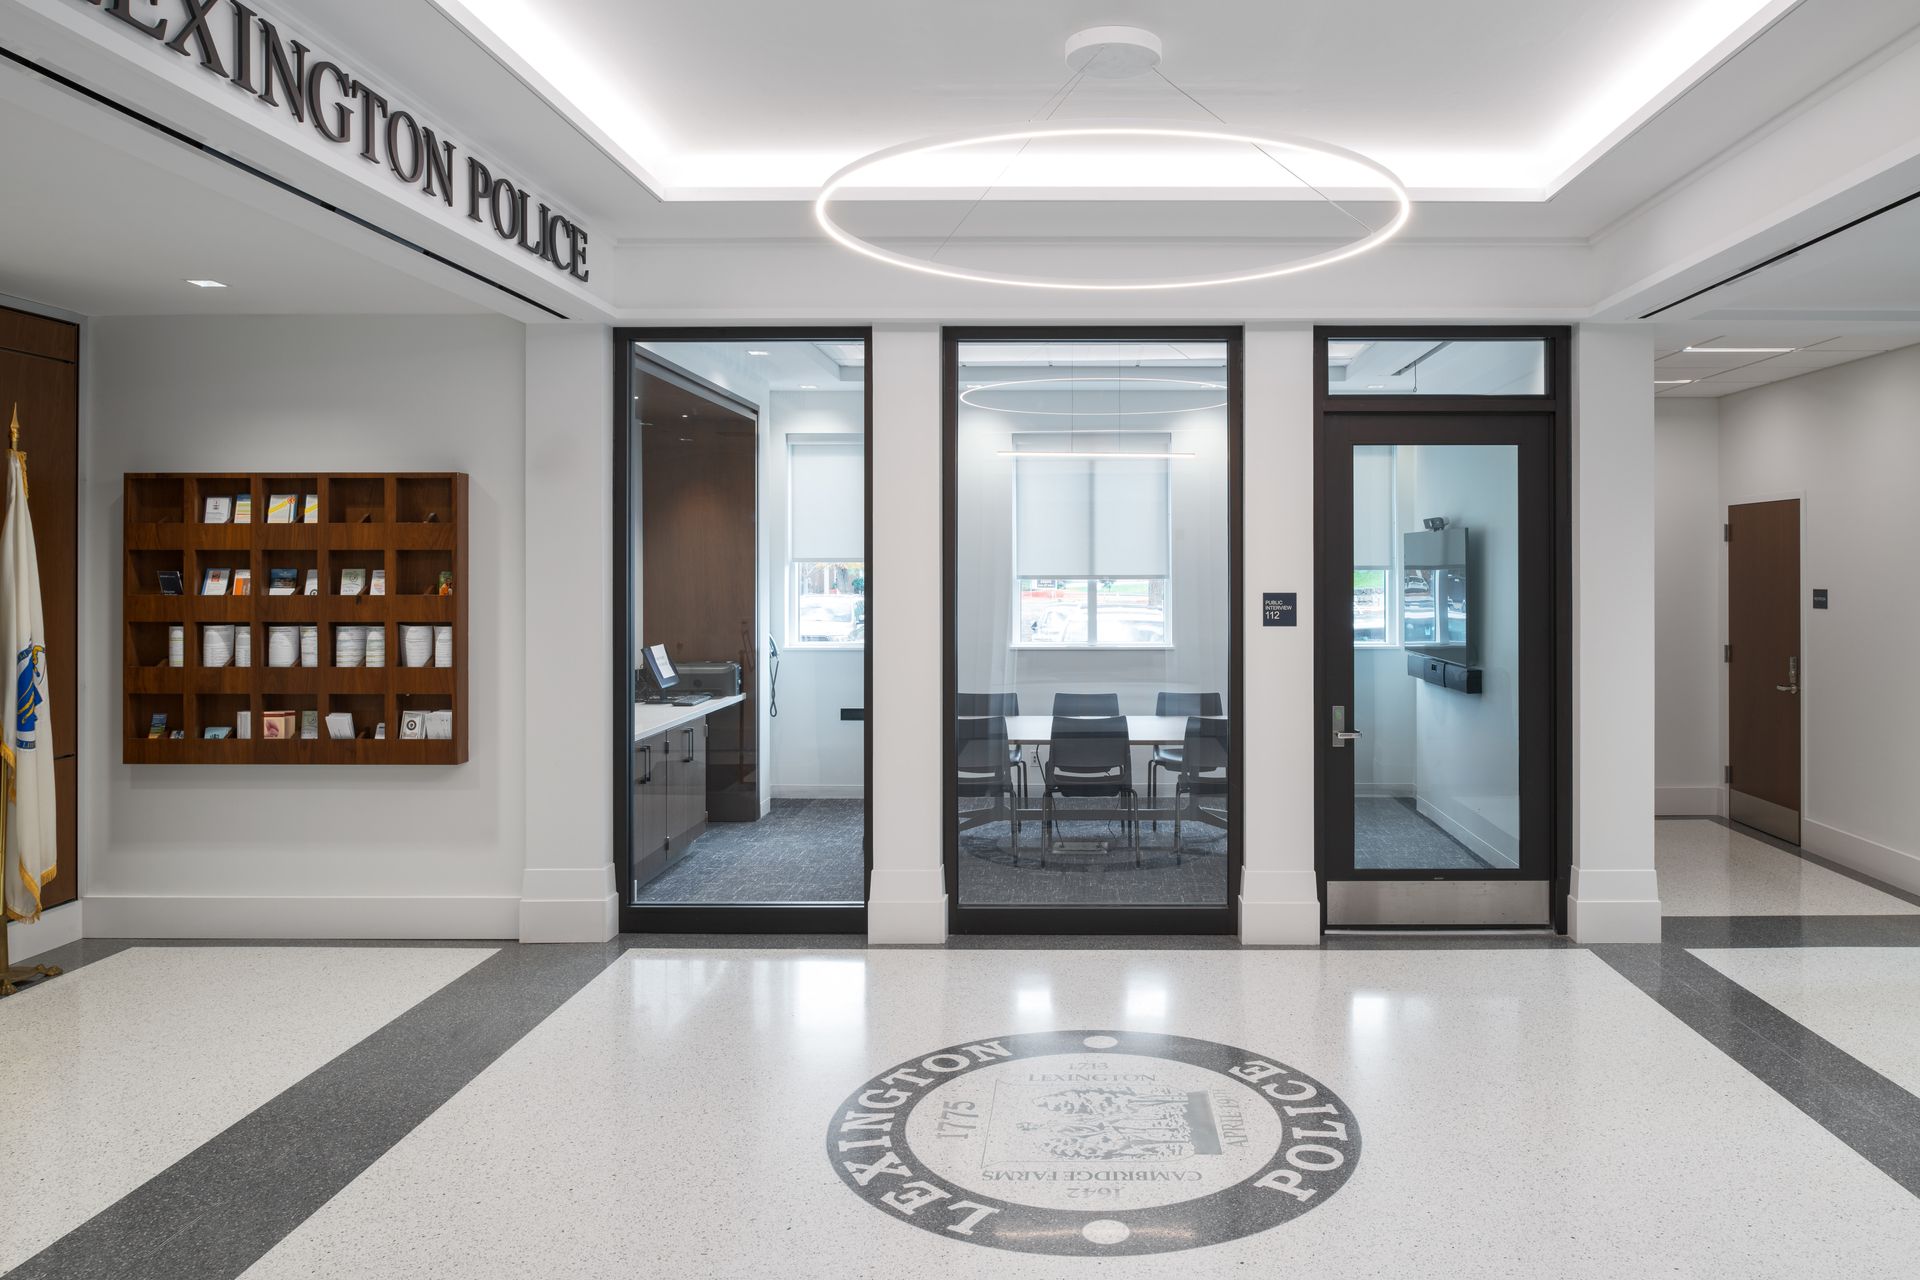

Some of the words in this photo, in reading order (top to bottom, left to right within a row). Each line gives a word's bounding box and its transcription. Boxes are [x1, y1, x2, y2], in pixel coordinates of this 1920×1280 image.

[467, 156, 589, 282] POLICE
[1265, 610, 1281, 620] 112
[1028, 1073, 1157, 1082] LEXINGTON
[936, 1100, 980, 1140] 1775
[1228, 1060, 1349, 1202] POLICE
[837, 1040, 1013, 1236] LEXINGTON
[981, 1170, 1058, 1182] FARMS
[1063, 1170, 1203, 1182] CAMBRIDGE
[1067, 1187, 1125, 1199] 1642
